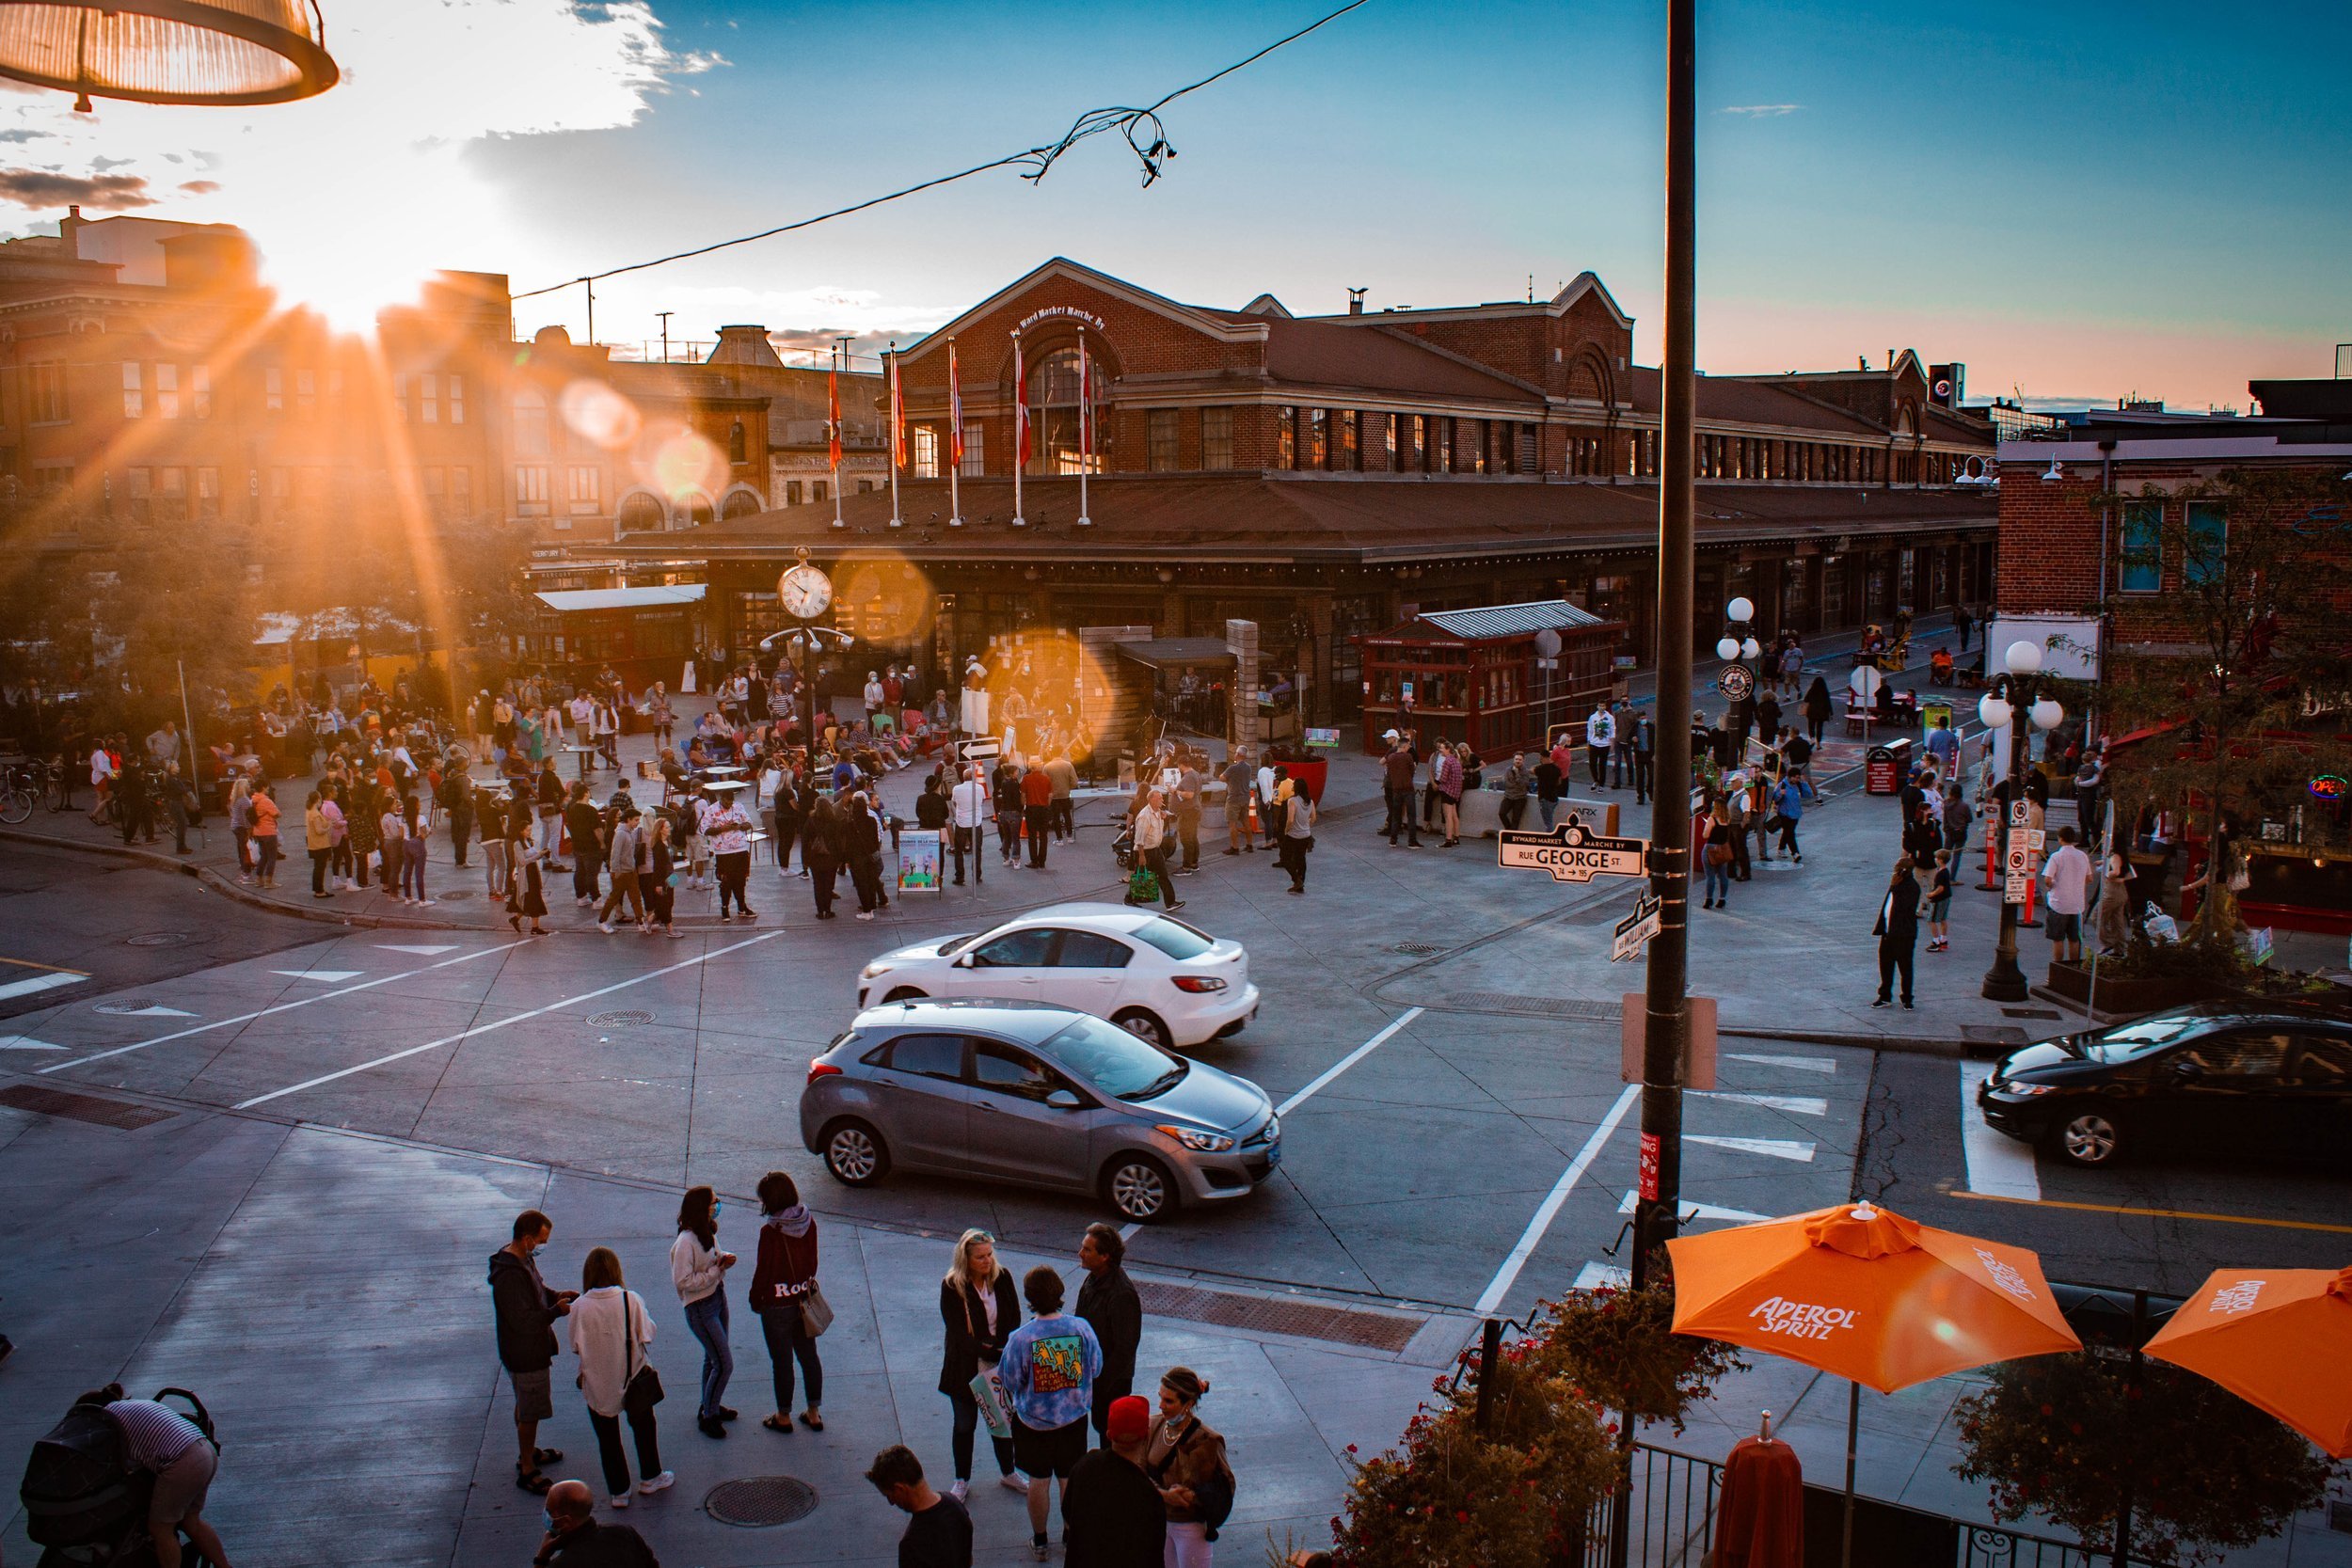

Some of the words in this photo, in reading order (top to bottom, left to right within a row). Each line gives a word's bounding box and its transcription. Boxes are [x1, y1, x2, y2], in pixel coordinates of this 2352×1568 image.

[1020, 311, 1039, 329] Ward
[1038, 306, 1066, 319] Market
[1094, 316, 1105, 331] By
[1512, 835, 1537, 844] BYWARD
[1537, 837, 1563, 846] MARKET
[1518, 851, 1534, 860] RUE
[1535, 848, 1610, 868] GEORGE
[1611, 857, 1622, 866] ST.
[1558, 867, 1565, 876] 74
[1748, 1296, 1855, 1329] APEROL
